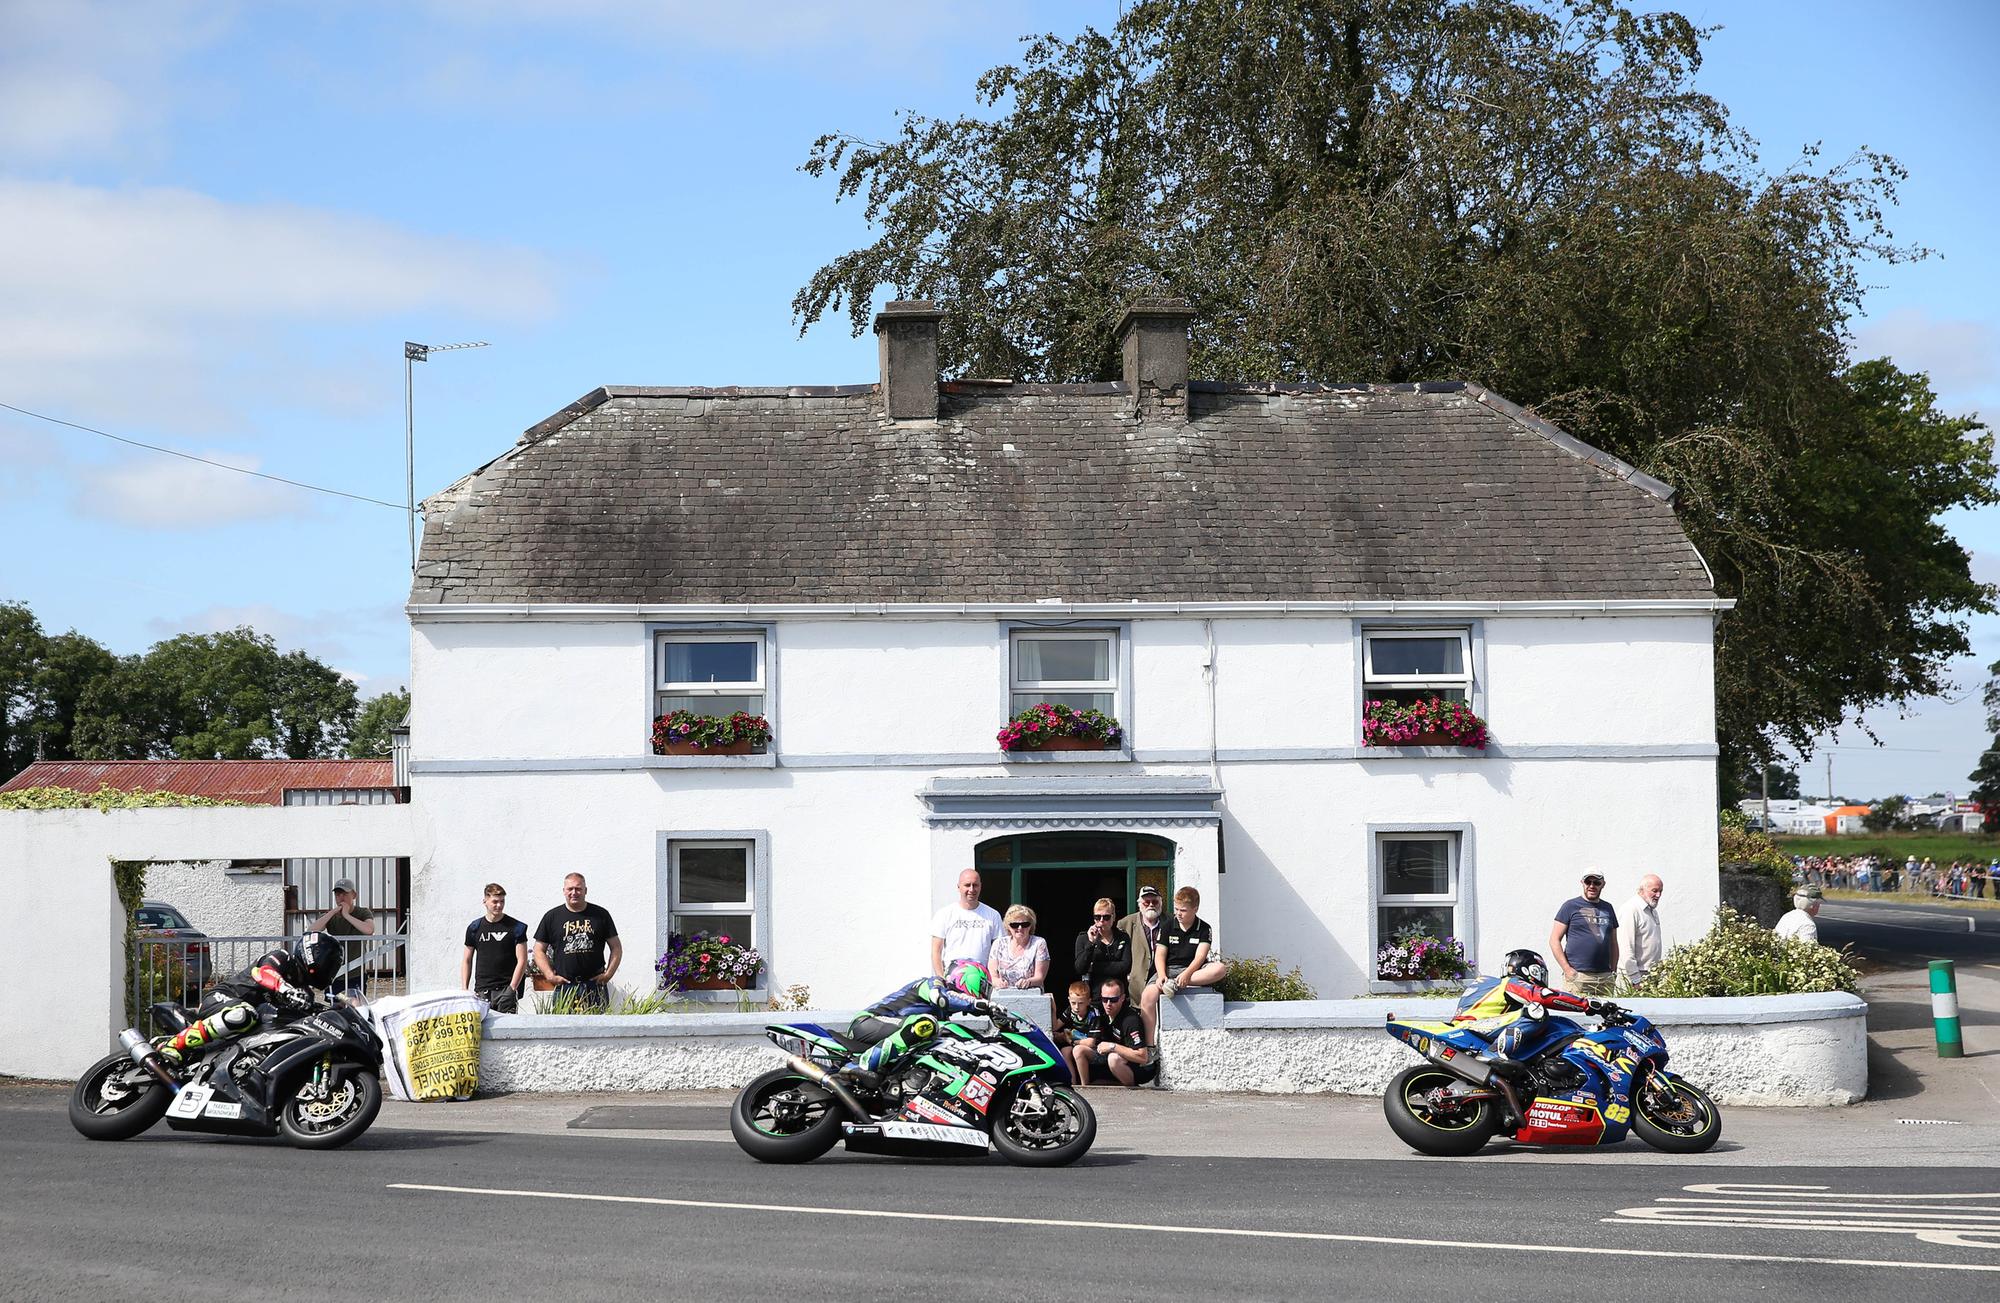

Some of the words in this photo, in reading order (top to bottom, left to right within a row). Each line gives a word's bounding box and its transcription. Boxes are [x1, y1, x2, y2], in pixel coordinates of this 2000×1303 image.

[432, 1016, 451, 1029] 792
[455, 1012, 474, 1025] 087
[434, 1027, 453, 1040] 668
[456, 1024, 474, 1036] 043
[414, 1065, 457, 1089] GRAVEL
[1535, 1102, 1571, 1112] DUNLOP
[1604, 1103, 1630, 1124] 82
[1529, 1109, 1562, 1121] MOTUL
